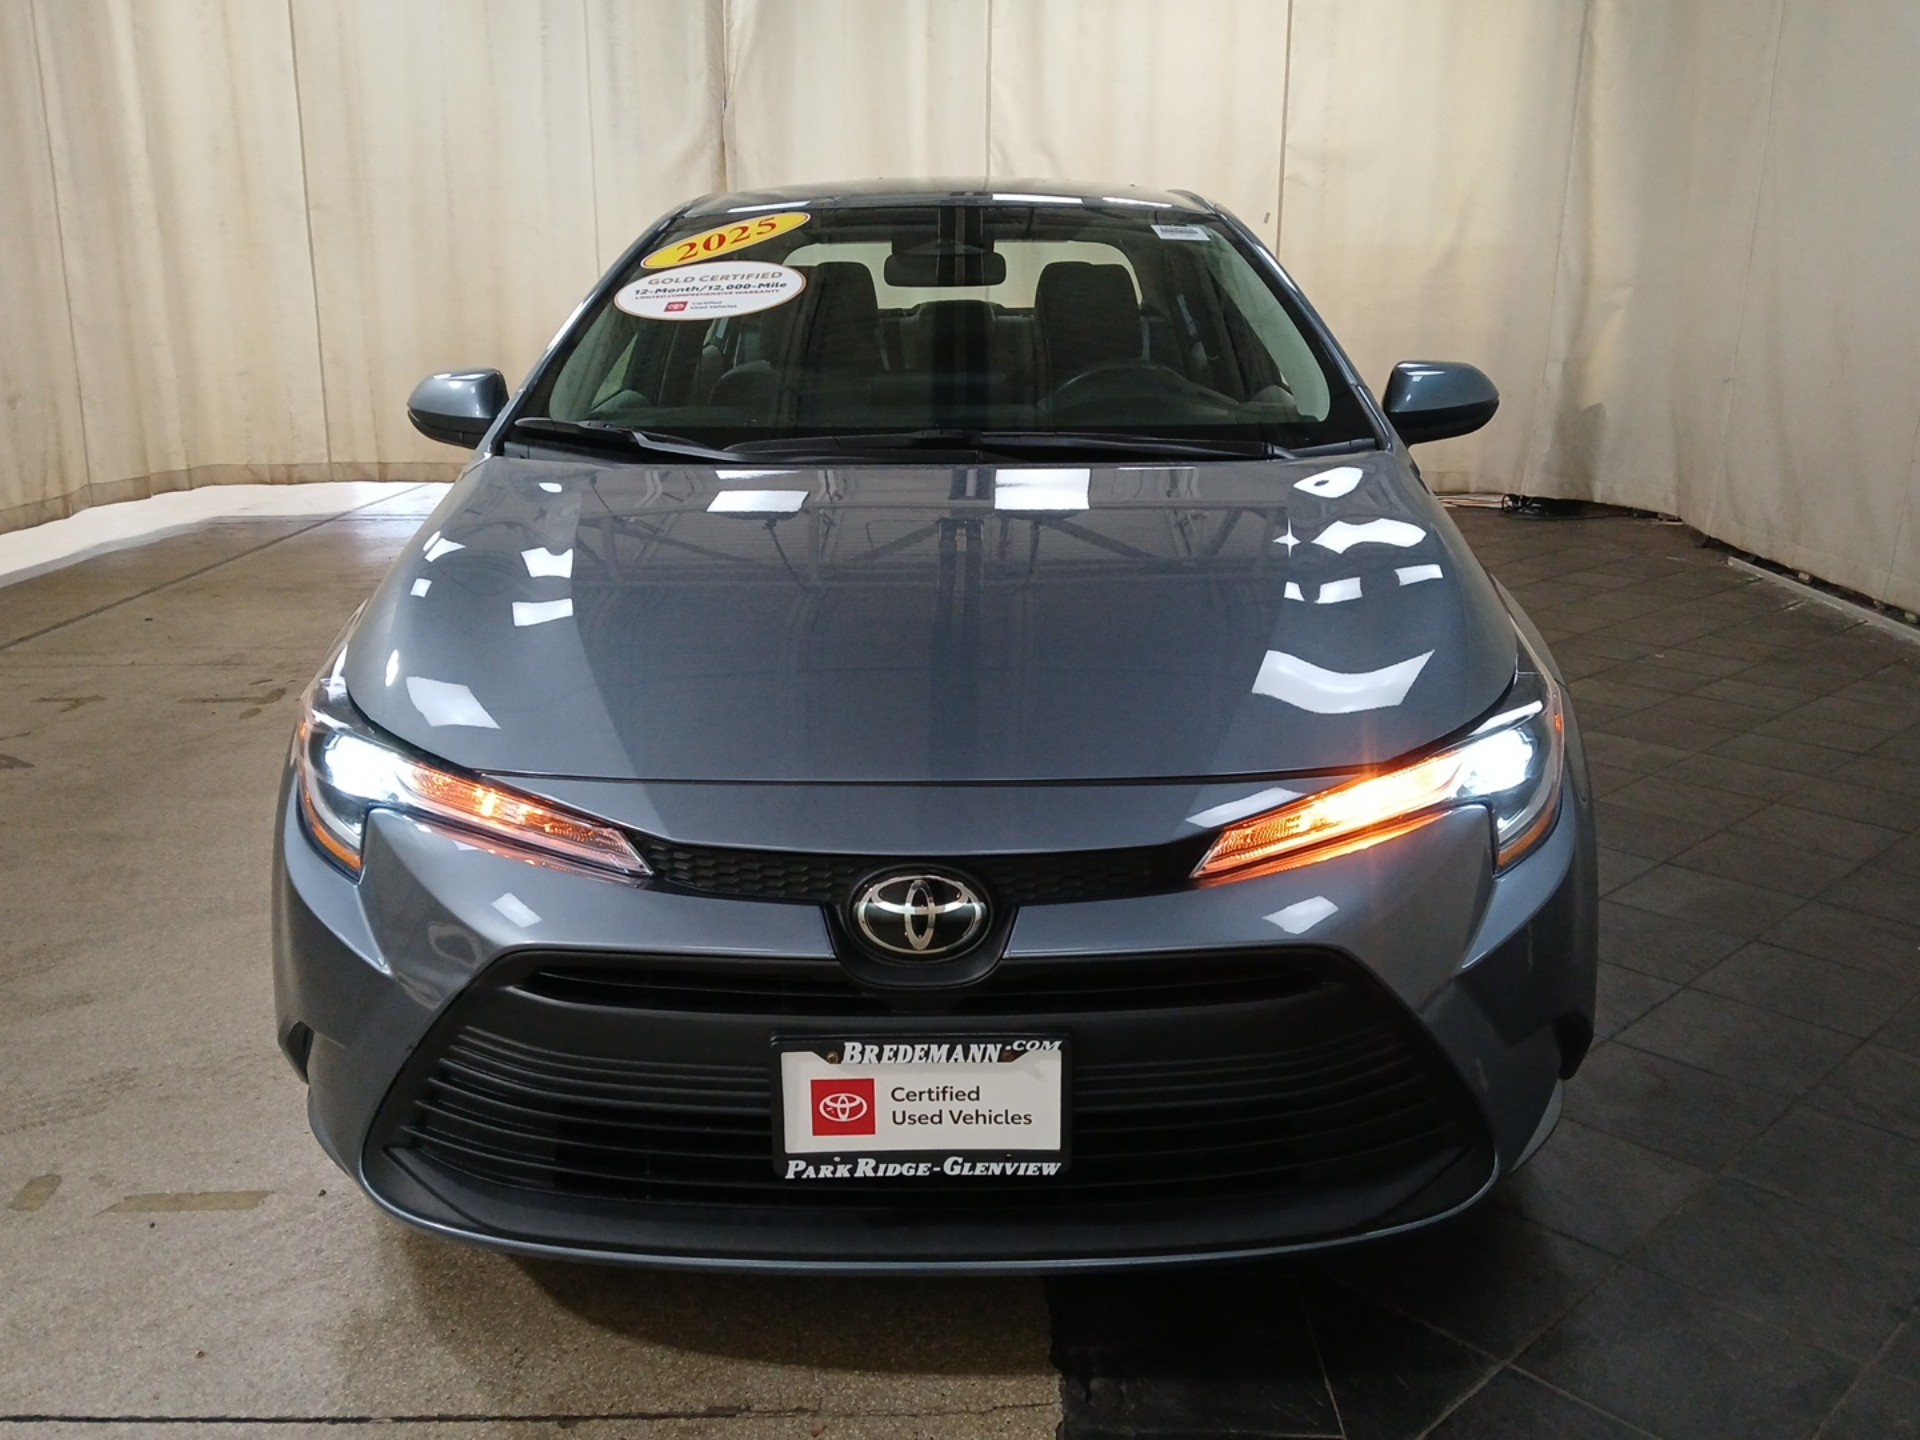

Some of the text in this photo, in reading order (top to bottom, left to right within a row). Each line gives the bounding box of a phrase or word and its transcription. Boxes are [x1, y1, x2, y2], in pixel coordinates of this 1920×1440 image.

[676, 216, 777, 262] 2025
[648, 271, 783, 285] GOLD CERTIFIED
[890, 1085, 980, 1102] Certified
[891, 1109, 1033, 1126] Used Vehicles
[785, 1160, 853, 1180] PARK
